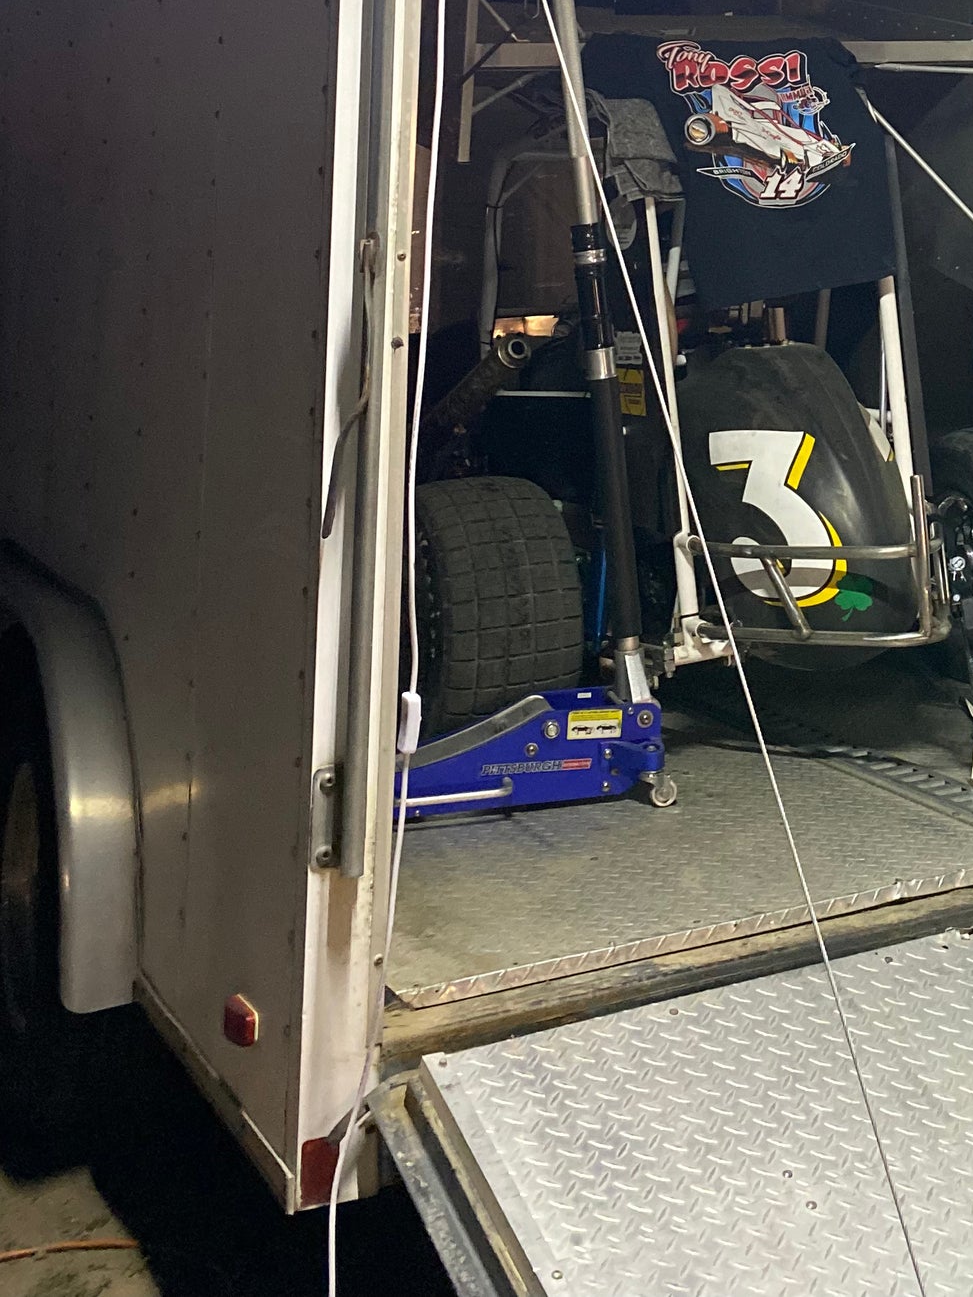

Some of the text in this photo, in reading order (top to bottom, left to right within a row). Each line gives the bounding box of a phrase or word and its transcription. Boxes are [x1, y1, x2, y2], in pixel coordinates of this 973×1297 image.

[657, 40, 712, 72] Tony
[672, 52, 801, 91] ROSSI
[759, 167, 804, 200] 14
[709, 430, 846, 606] 3
[481, 759, 563, 777] PITTSBURGH
